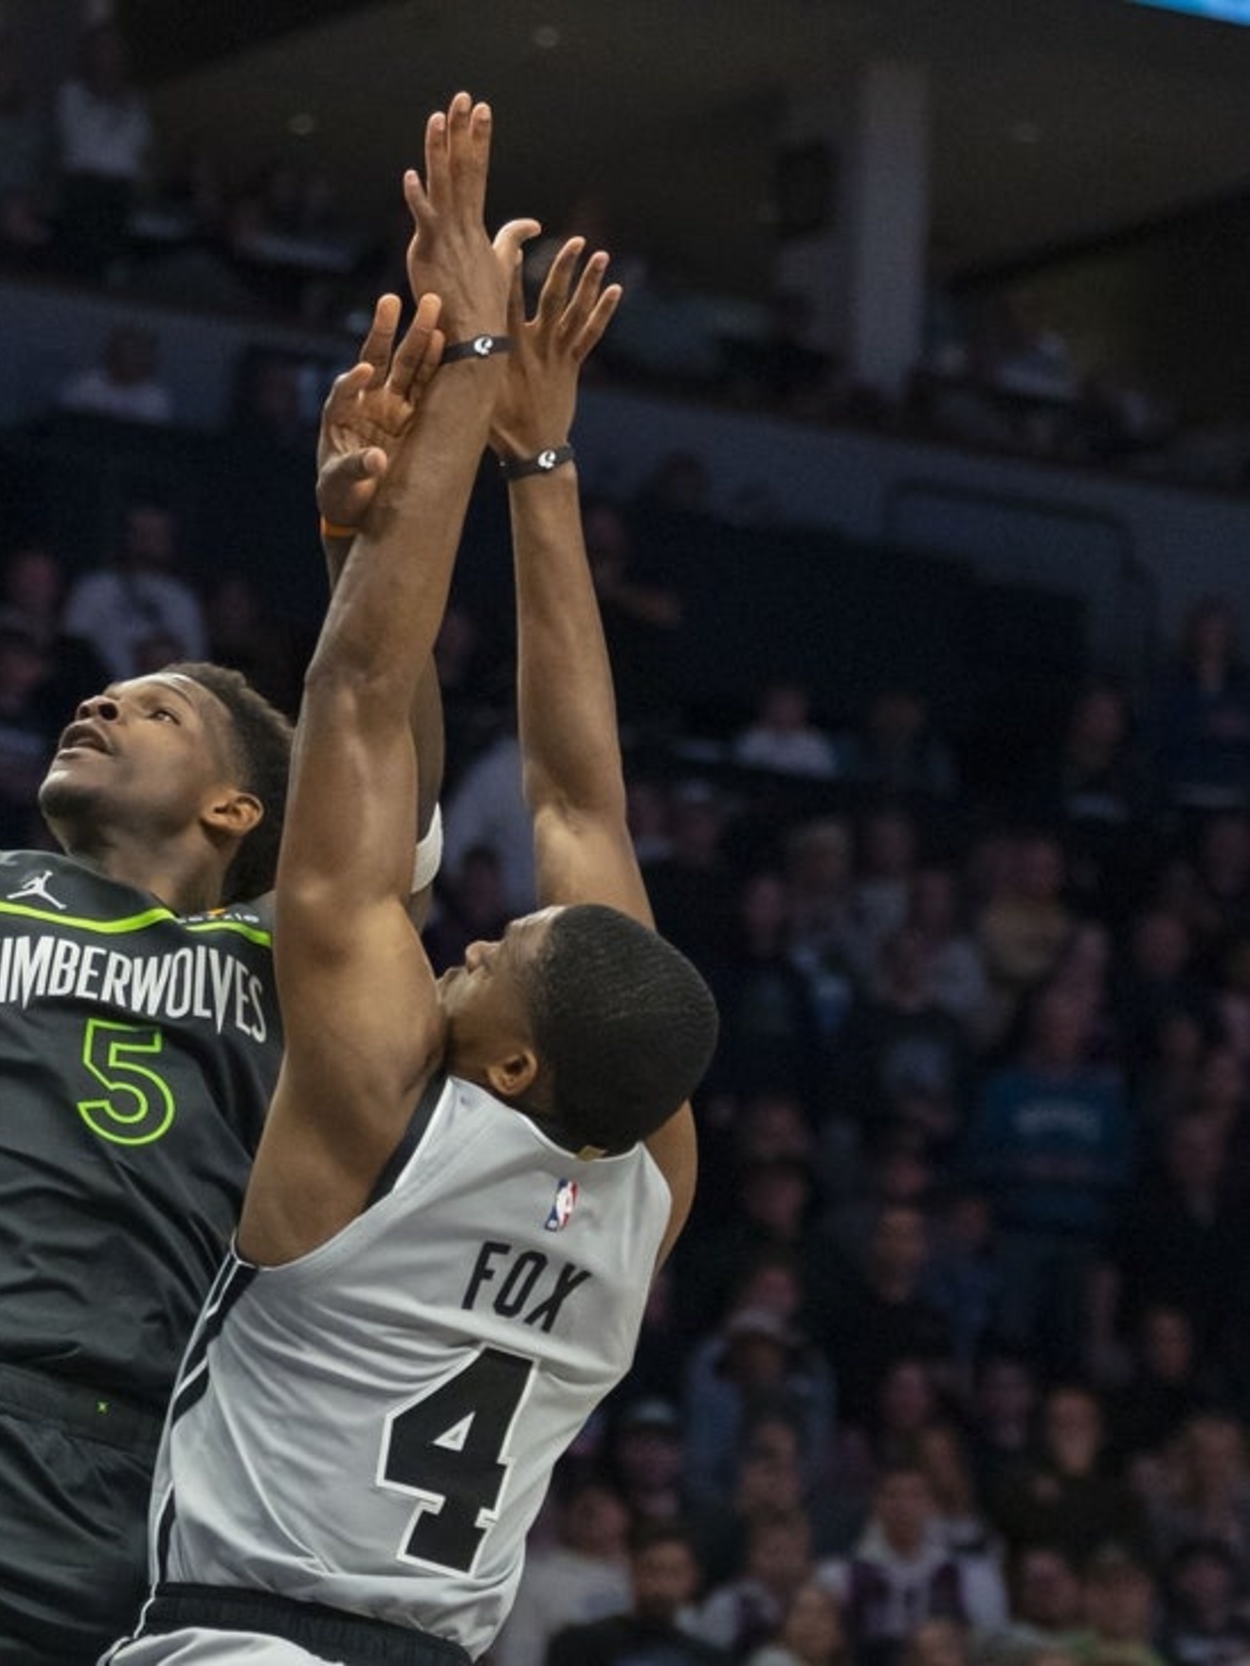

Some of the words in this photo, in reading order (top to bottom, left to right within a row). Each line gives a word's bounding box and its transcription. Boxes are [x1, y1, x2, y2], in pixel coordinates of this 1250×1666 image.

[76, 1017, 176, 1146] 5
[460, 1240, 593, 1334] FOX
[375, 1341, 541, 1579] 4
